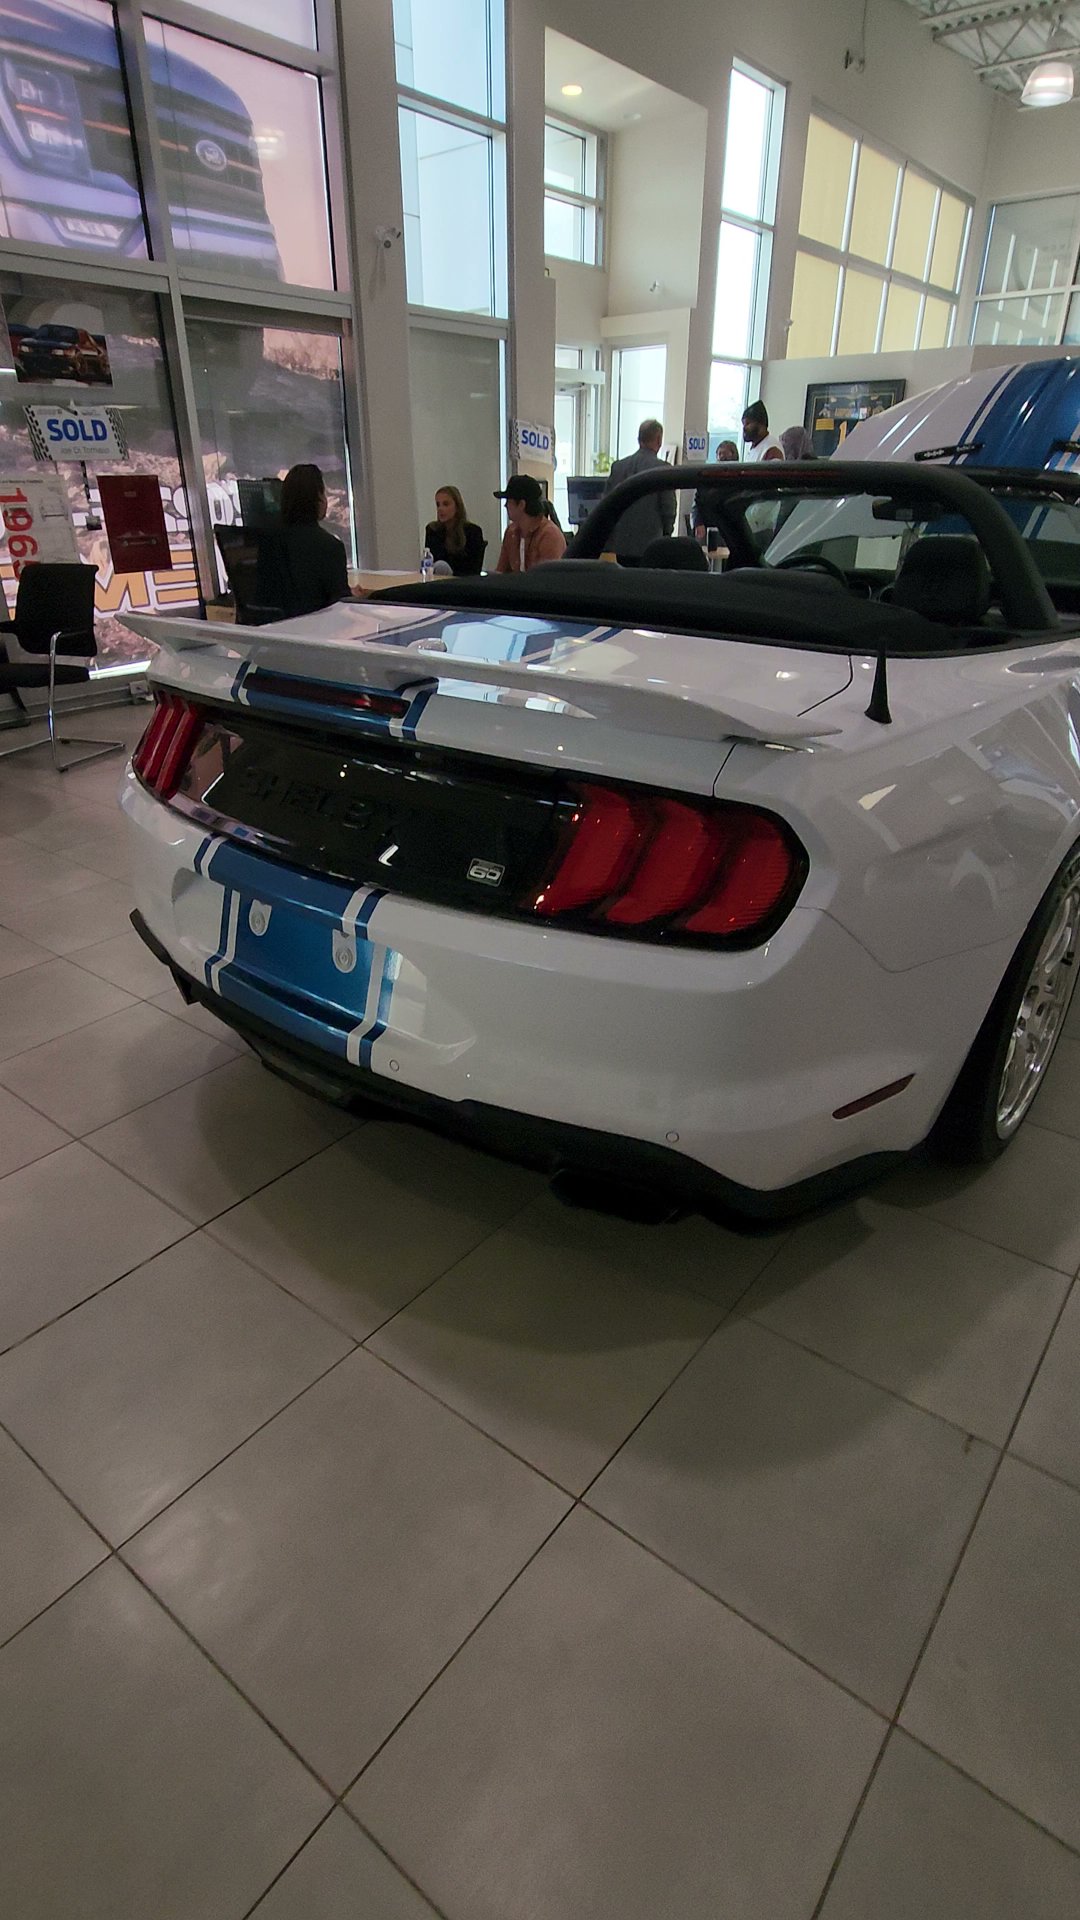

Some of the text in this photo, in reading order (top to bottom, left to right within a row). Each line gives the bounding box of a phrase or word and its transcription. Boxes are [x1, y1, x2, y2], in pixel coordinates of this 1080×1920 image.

[46, 418, 108, 442] SOLD
[521, 429, 549, 451] SOLD
[688, 437, 706, 450] SOLD
